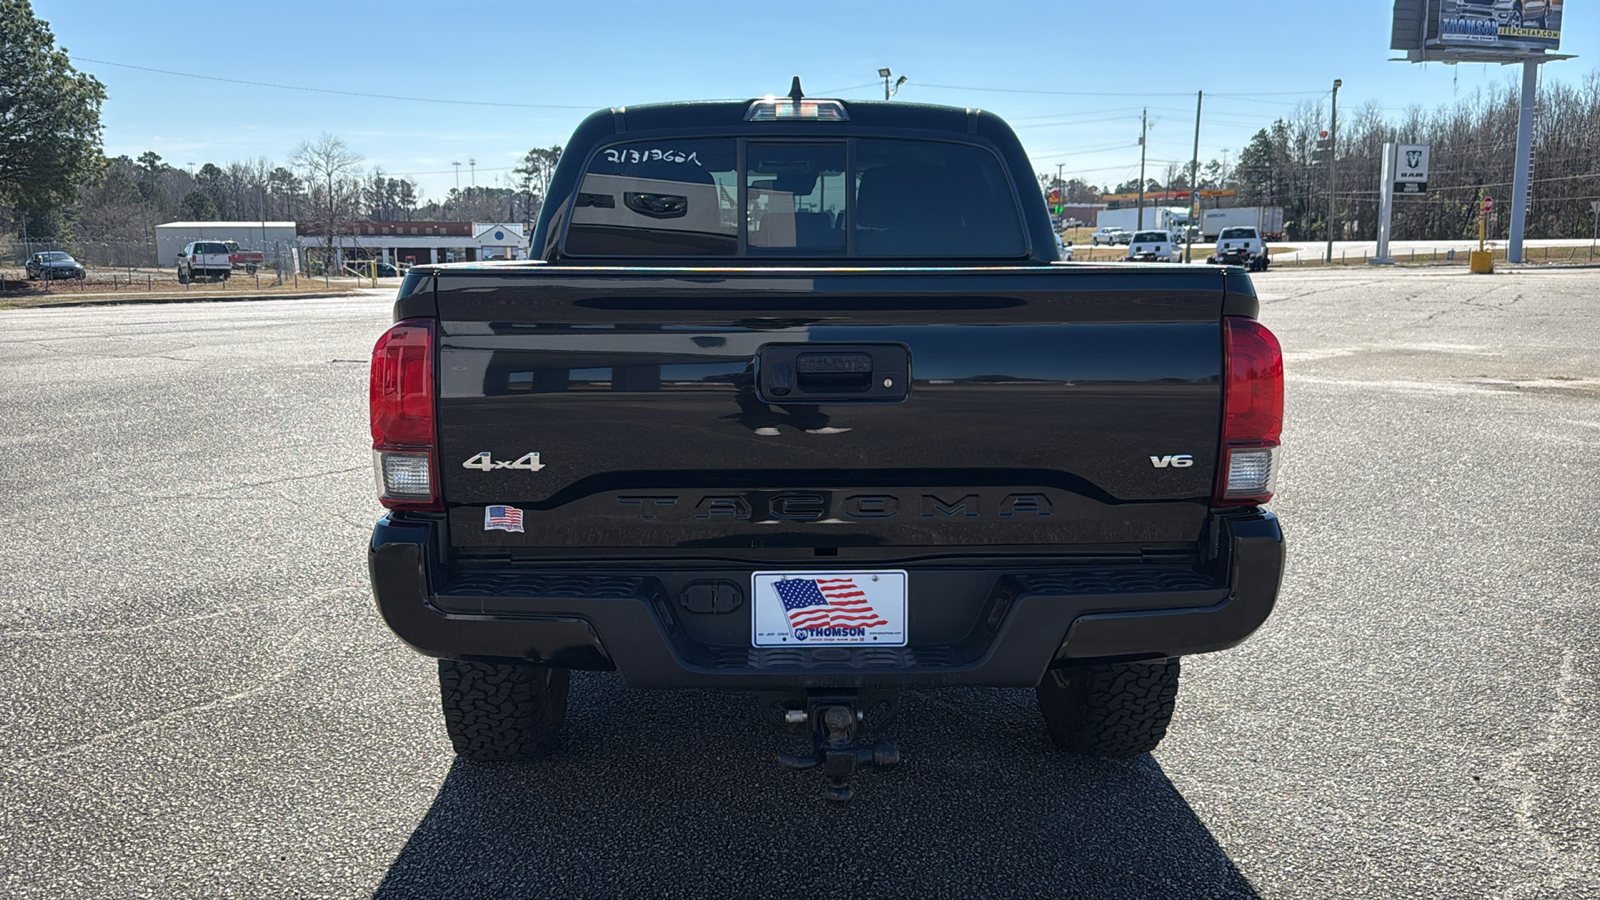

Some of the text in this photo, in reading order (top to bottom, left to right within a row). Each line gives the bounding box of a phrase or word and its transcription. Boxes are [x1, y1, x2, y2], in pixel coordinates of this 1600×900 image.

[1443, 18, 1499, 35] THOMSON
[1499, 27, 1558, 38] JEEPCHEAP.COM
[802, 358, 867, 371] TOYOTA
[462, 451, 546, 472] 4x4
[1149, 454, 1194, 468] V6
[616, 493, 1053, 519] TACOMA
[809, 627, 865, 637] THOMSON
